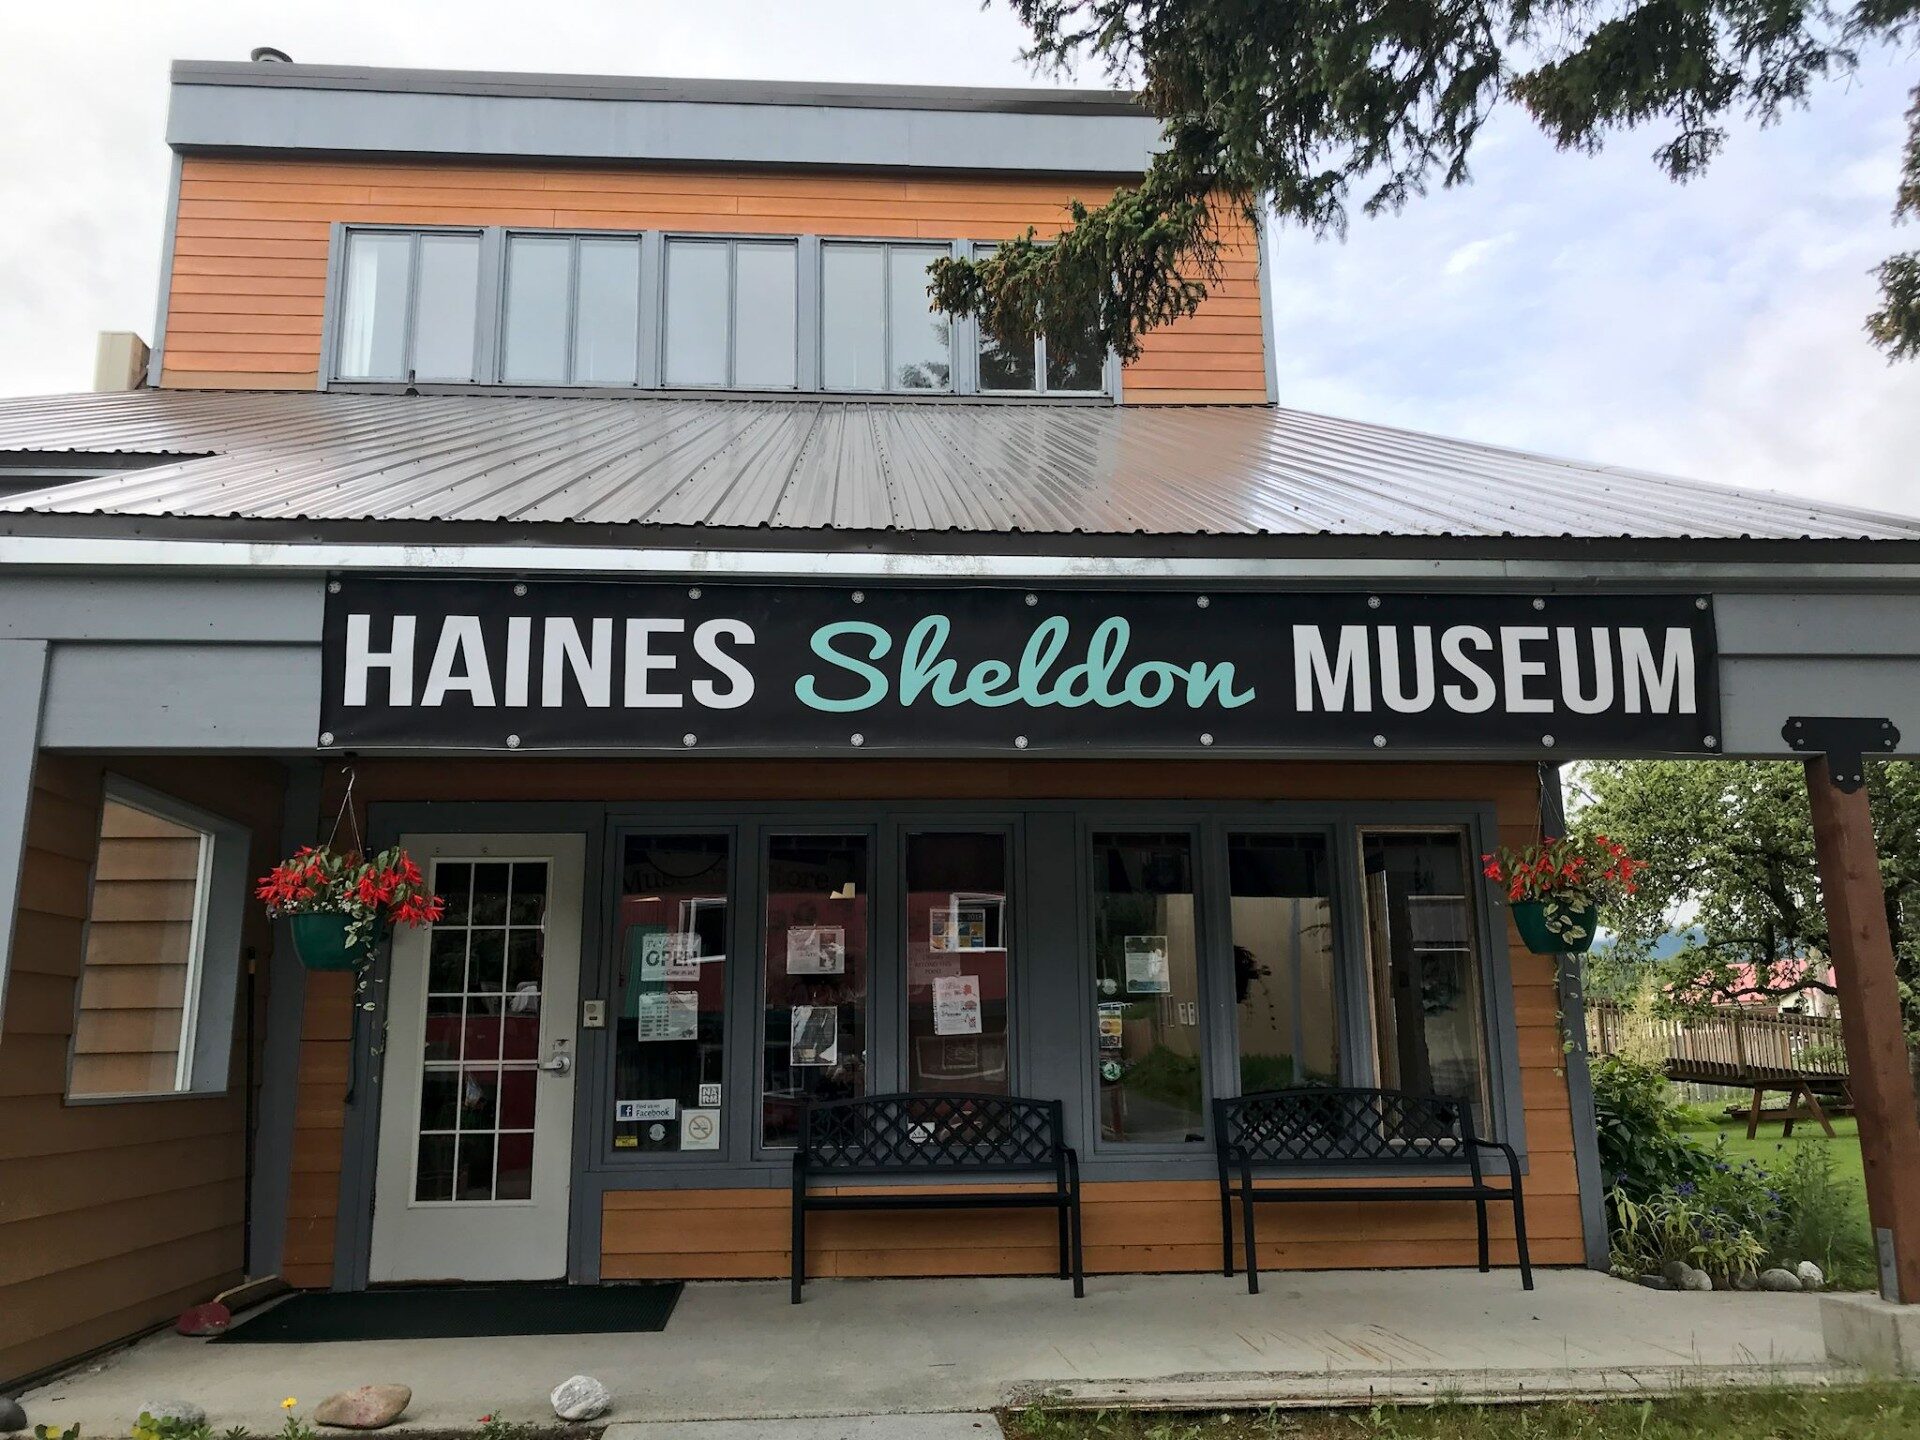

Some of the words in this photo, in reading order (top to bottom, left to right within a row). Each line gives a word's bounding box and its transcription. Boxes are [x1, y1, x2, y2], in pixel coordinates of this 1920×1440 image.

[344, 614, 755, 709] HAINES
[795, 615, 1255, 712] Sheldon
[1293, 625, 1696, 714] MUSEUM
[646, 951, 698, 967] OPEN
[636, 1109, 669, 1117] Facebook
